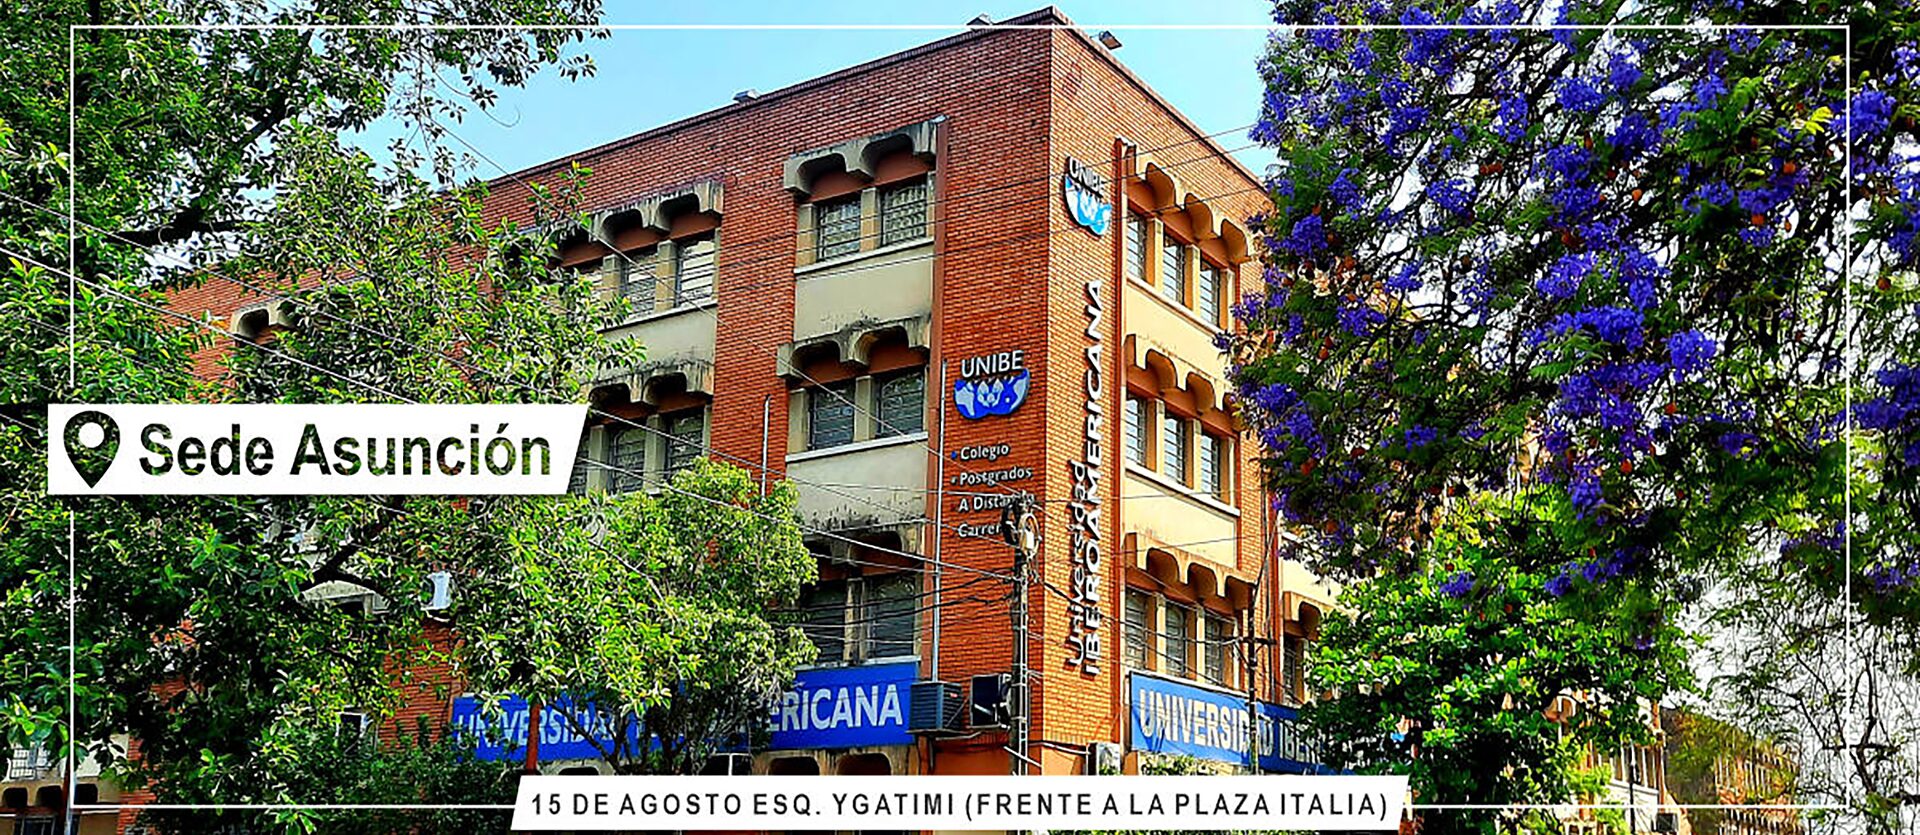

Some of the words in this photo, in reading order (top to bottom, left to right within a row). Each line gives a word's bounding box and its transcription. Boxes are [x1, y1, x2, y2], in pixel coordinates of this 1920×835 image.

[1068, 155, 1106, 192] UNIBE
[961, 350, 1024, 377] UNIBE
[960, 443, 1010, 462] Colegio
[959, 466, 1032, 487] Postgrados
[1085, 279, 1102, 676] IBEROAMERICANA
[958, 498, 969, 512] A
[958, 522, 1002, 538] Carrer
[1068, 460, 1086, 665] Universidad
[457, 709, 619, 750] UNVERSIDA
[1139, 688, 1274, 756] UNIVERSIDD
